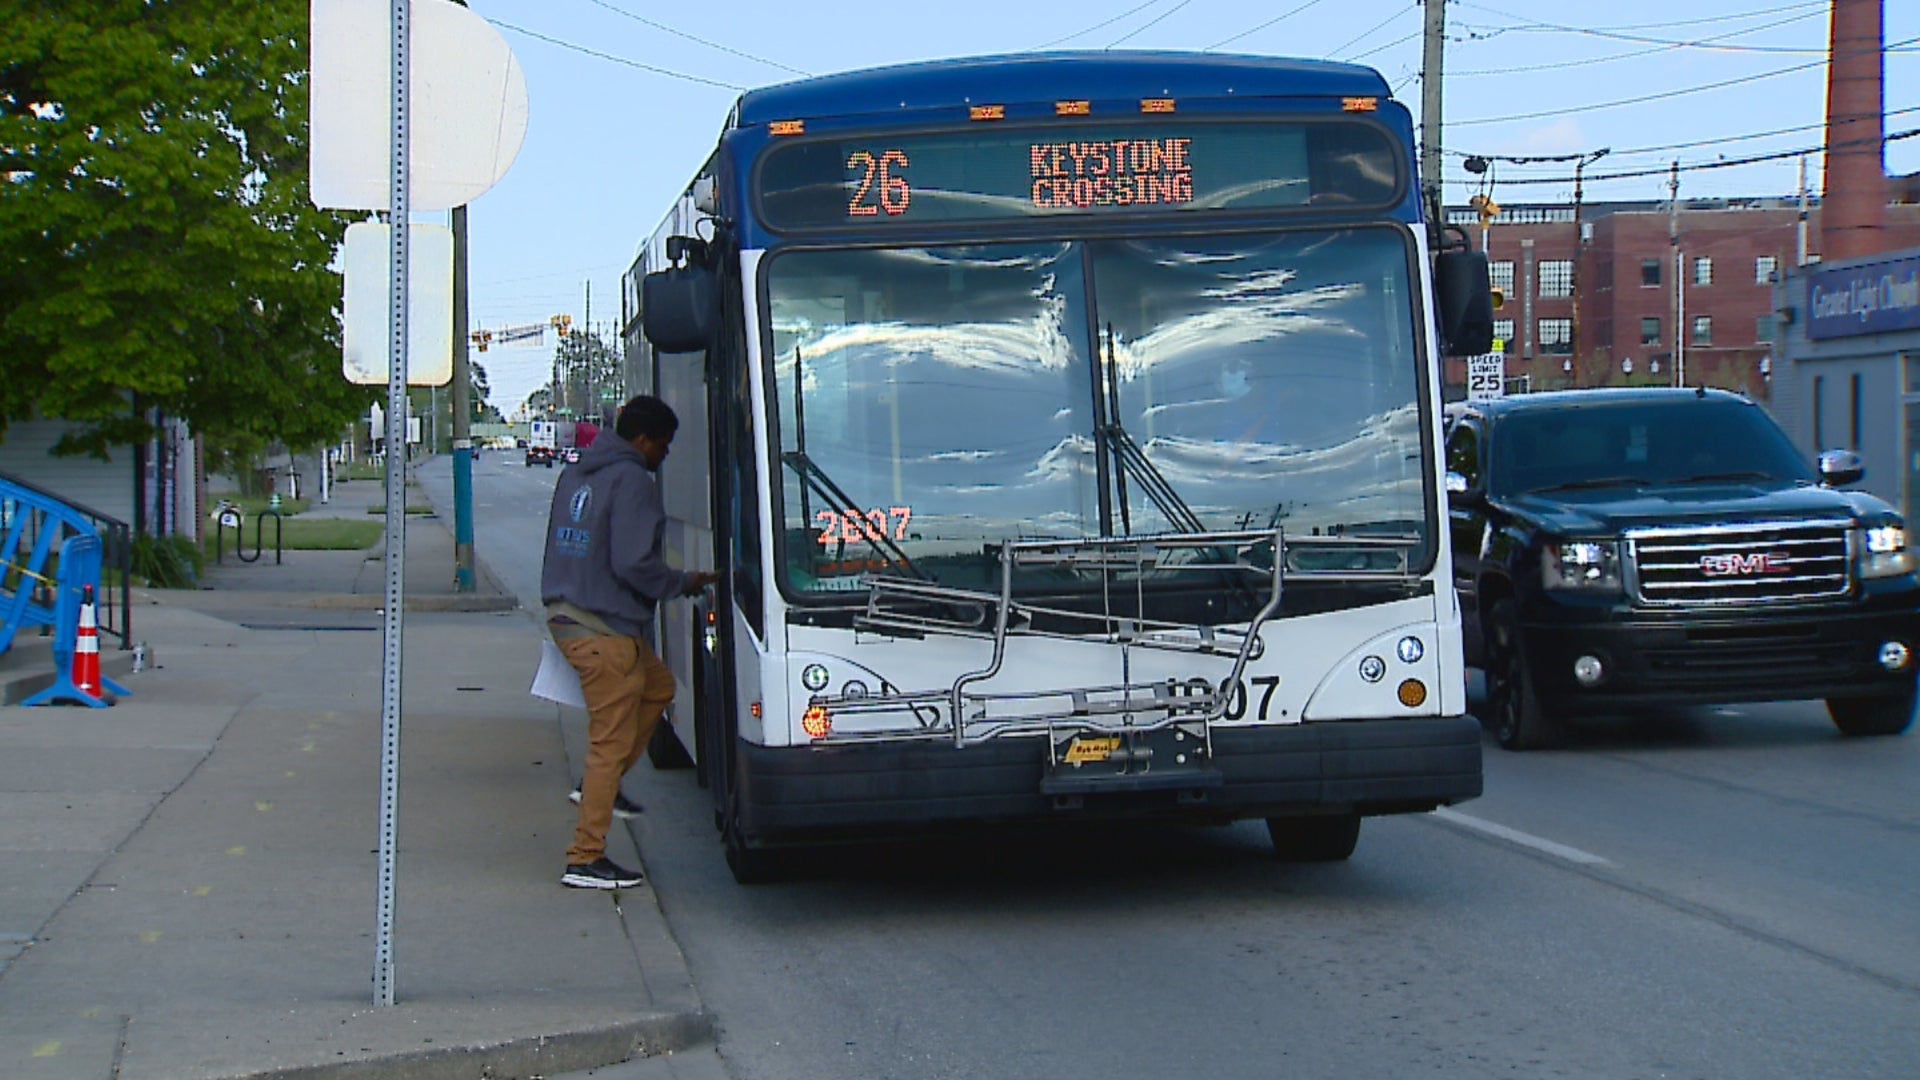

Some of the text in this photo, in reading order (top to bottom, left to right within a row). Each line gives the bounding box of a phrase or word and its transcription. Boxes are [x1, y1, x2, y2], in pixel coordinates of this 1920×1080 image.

[1031, 138, 1192, 176] KEYSTONE
[847, 150, 909, 216] 26
[1032, 173, 1193, 208] CROSSING
[1472, 375, 1500, 391] 25
[1700, 551, 1792, 577] GMC
